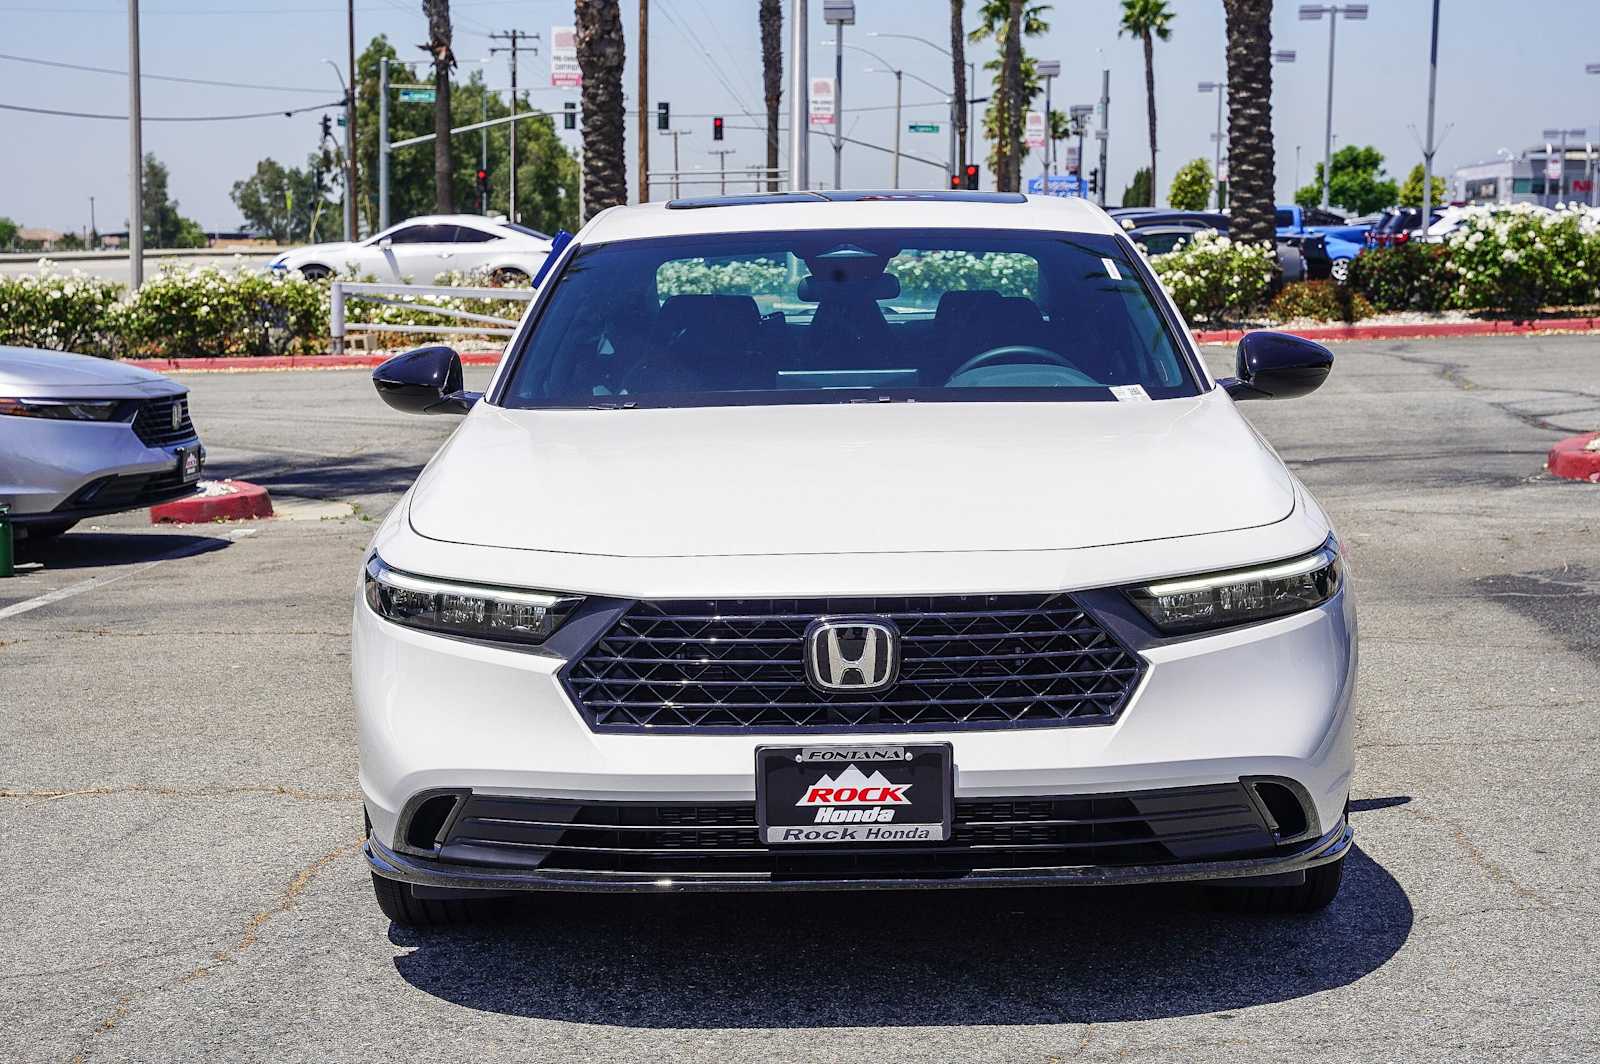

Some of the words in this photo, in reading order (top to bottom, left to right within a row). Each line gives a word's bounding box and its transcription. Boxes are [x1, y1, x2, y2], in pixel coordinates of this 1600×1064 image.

[808, 750, 901, 760] FONTANA
[807, 787, 904, 802] ROCK
[814, 807, 895, 823] Honda
[782, 828, 857, 841] Rock
[866, 827, 929, 839] Honda
